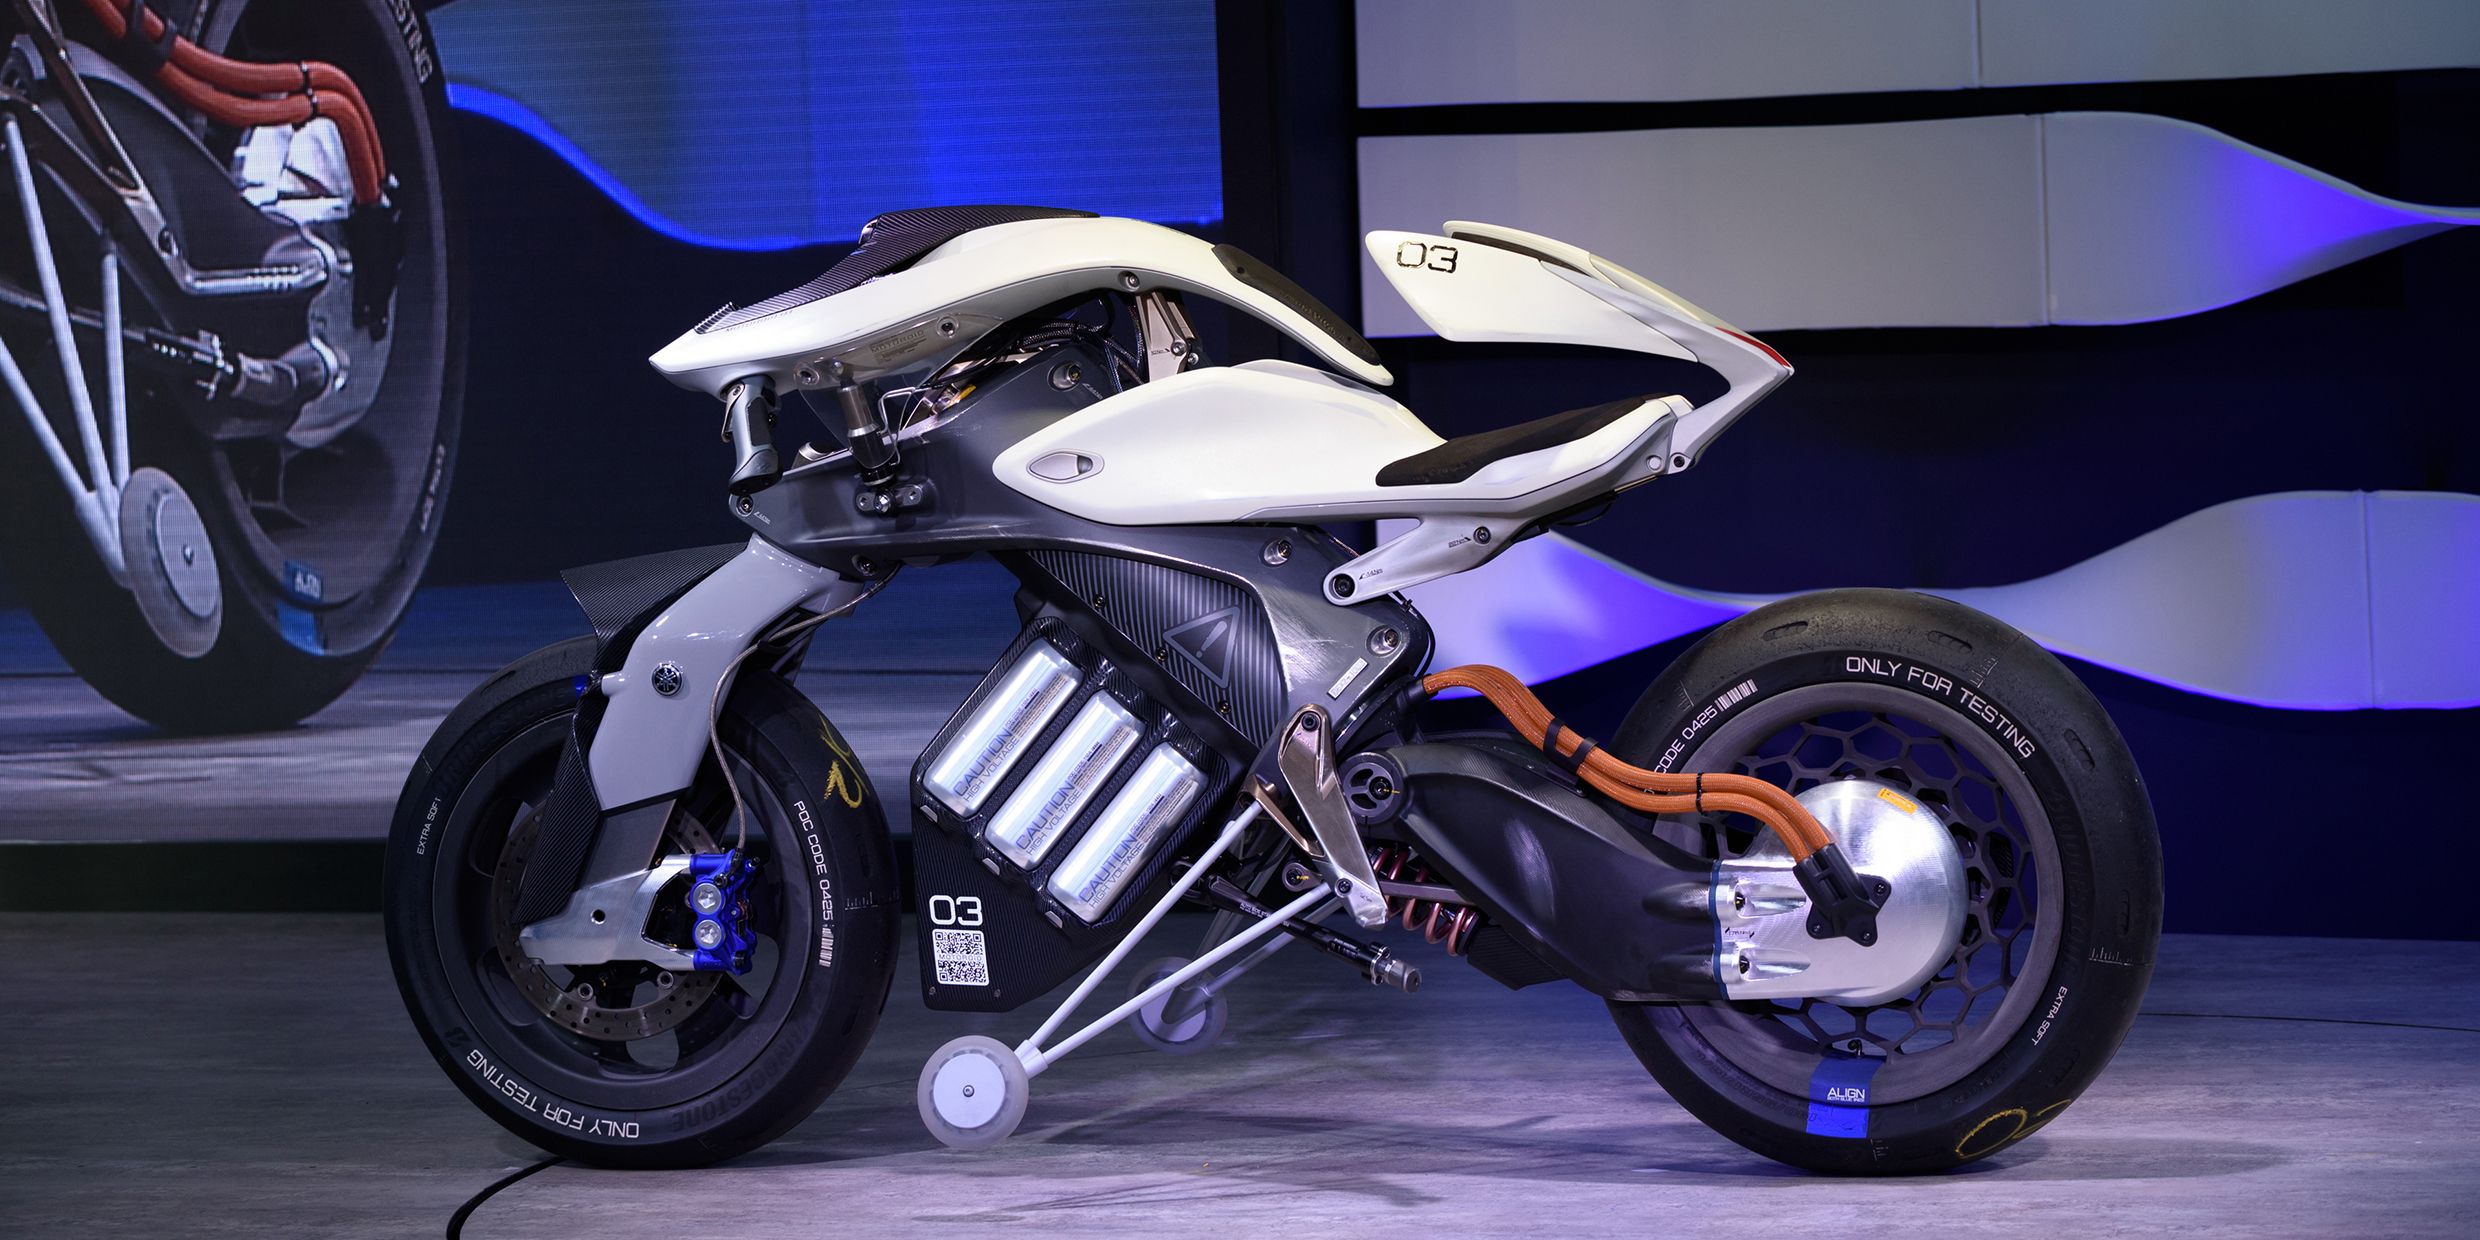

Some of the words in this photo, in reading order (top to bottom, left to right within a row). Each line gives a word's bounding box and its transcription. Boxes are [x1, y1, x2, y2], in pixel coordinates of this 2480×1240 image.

[387, 0, 433, 84] STING
[1396, 241, 1459, 274] 03
[1654, 738, 1685, 774] CODE
[1682, 704, 1718, 740] 0425
[1846, 656, 1902, 677] ONLY
[1907, 666, 1953, 696] FOR
[1959, 687, 2036, 758] TESTING
[952, 726, 1013, 796] CAUTION
[963, 779, 985, 802] HIGH
[982, 737, 1021, 777] VOLTAGE
[416, 823, 432, 855] EXTRA
[1015, 780, 1075, 850] CAUTION
[1026, 832, 1048, 855] HIGH
[1045, 789, 1082, 831] VOLTAGE
[794, 800, 814, 832] POC
[807, 834, 828, 876] CODE
[819, 879, 834, 921] 0425
[1078, 832, 1138, 903] CAUTION
[1088, 884, 1110, 910] HIGH
[1107, 843, 1145, 884] VOLTAGE
[929, 894, 983, 926] 03
[2031, 1020, 2051, 1046] SOFT
[2046, 986, 2068, 1019] EXTRA
[466, 1049, 539, 1112] TESTING
[1827, 1087, 1865, 1098] ALIGN
[543, 1103, 585, 1131] FOR
[588, 1119, 640, 1139] ONLY
